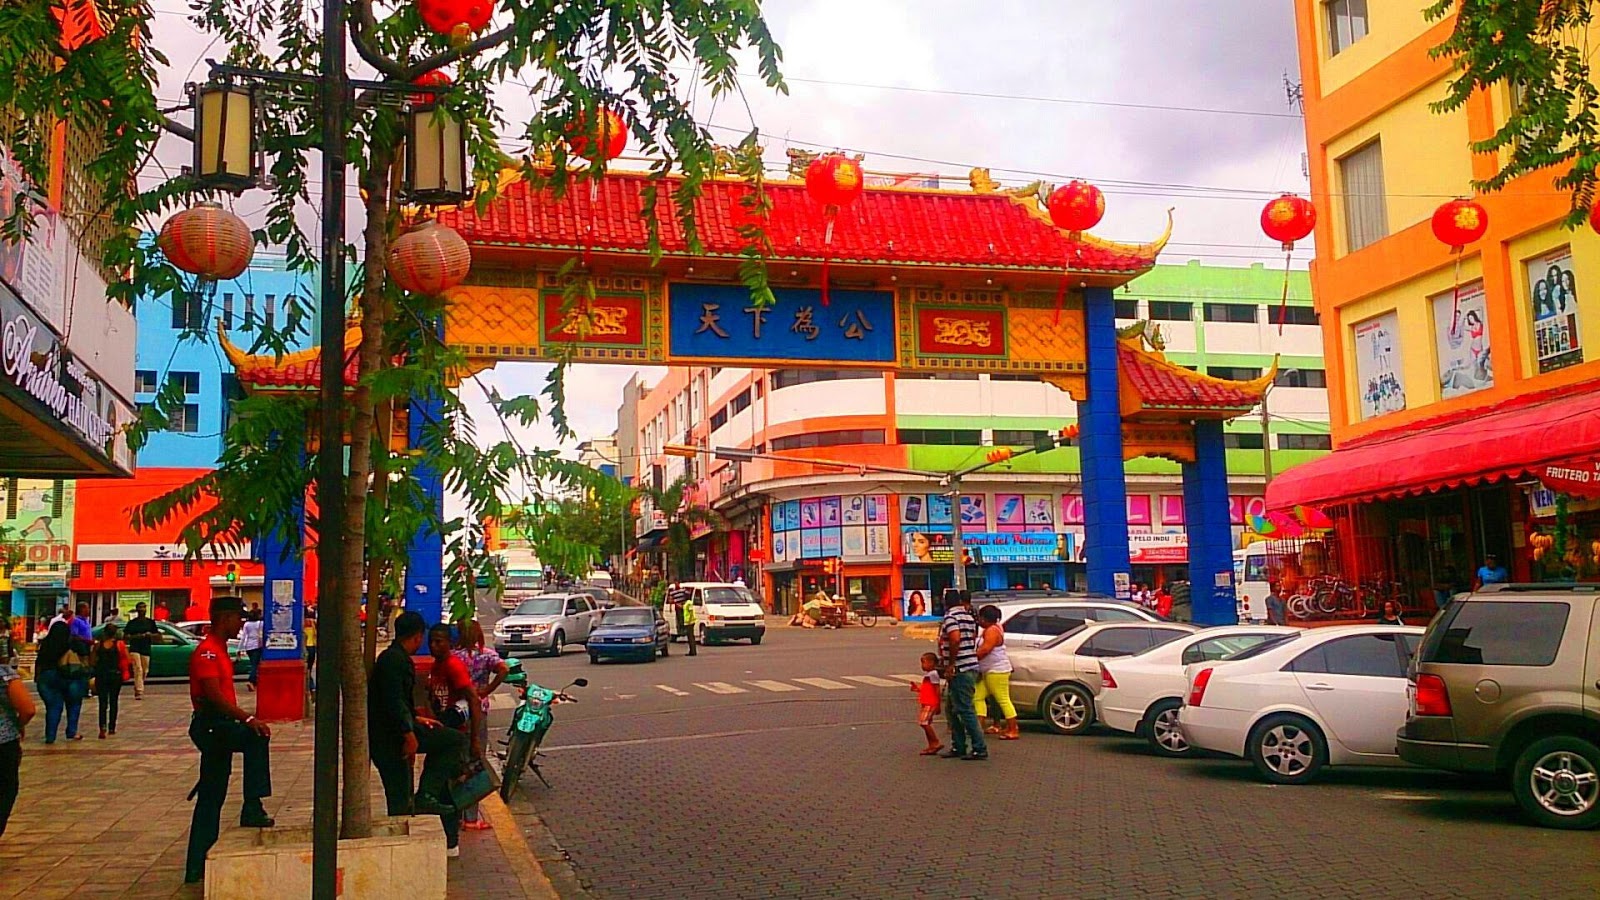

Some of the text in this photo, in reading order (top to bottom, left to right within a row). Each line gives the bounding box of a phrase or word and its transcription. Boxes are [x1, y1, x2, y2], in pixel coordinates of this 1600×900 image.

[695, 302, 874, 341] 天下為公
[1546, 466, 1590, 483] FRUTERO
